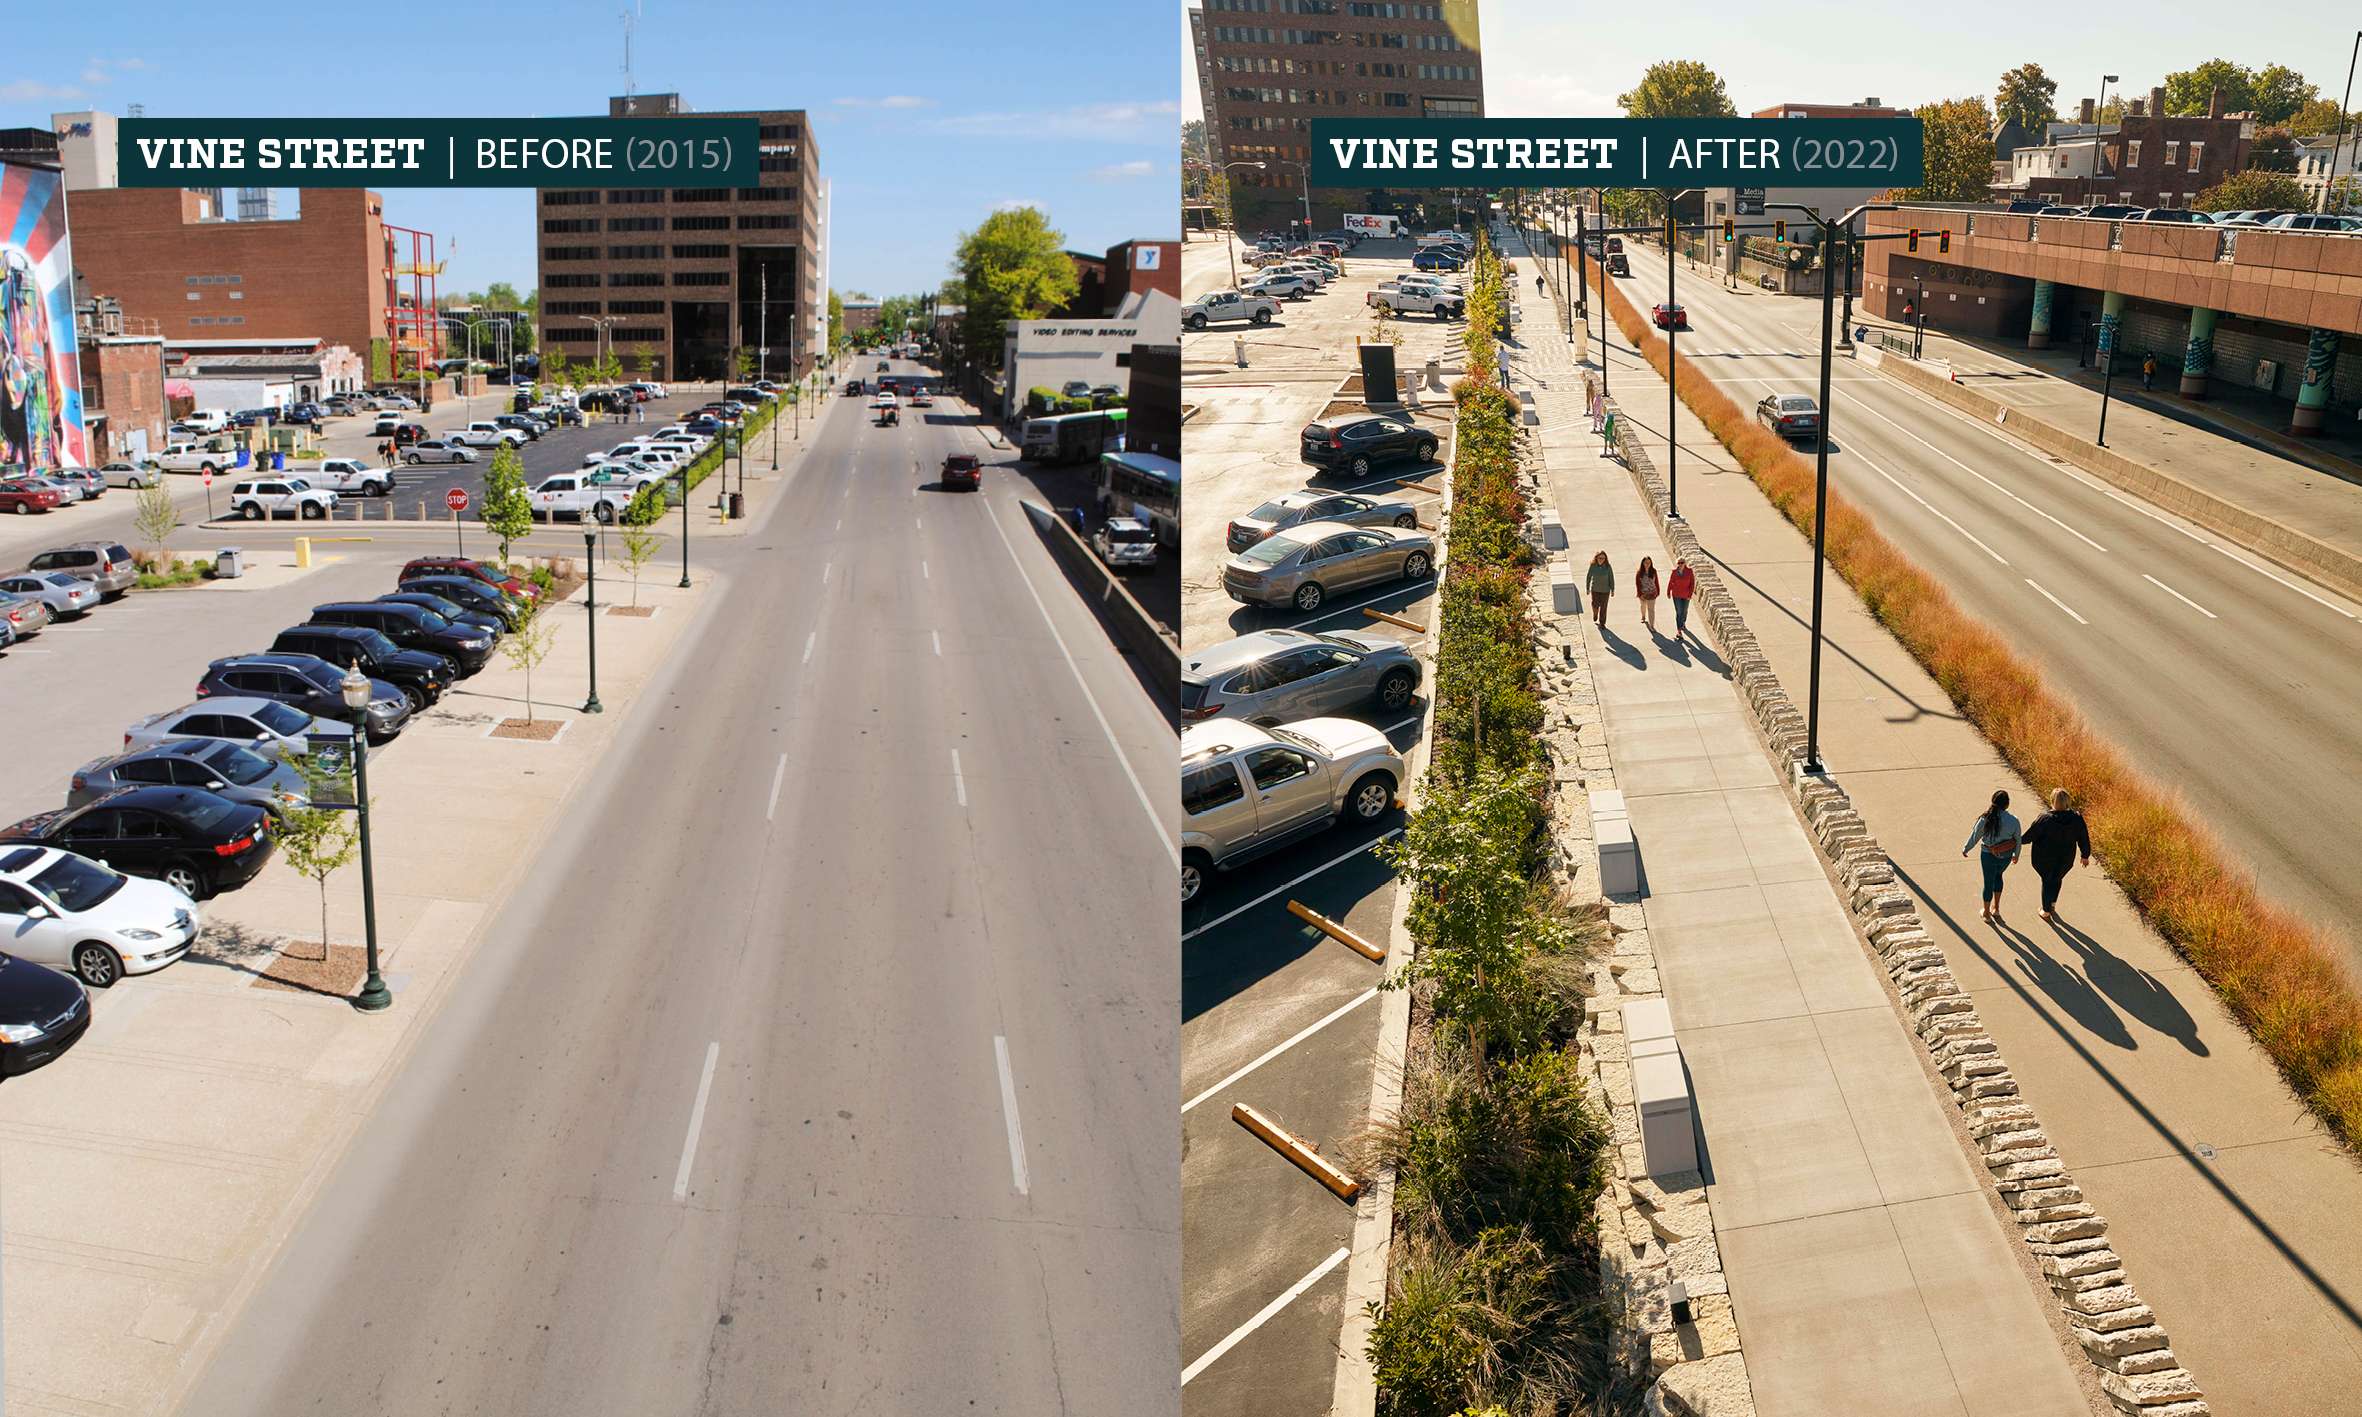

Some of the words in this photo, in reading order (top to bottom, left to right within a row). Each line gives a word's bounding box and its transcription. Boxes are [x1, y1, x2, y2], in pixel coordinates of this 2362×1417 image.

[1345, 215, 1382, 228] FedEx
[1033, 328, 1057, 336] VIDEO
[1061, 328, 1093, 336] EDITING
[1098, 328, 1137, 336] SERVICES
[448, 495, 467, 505] STOP
